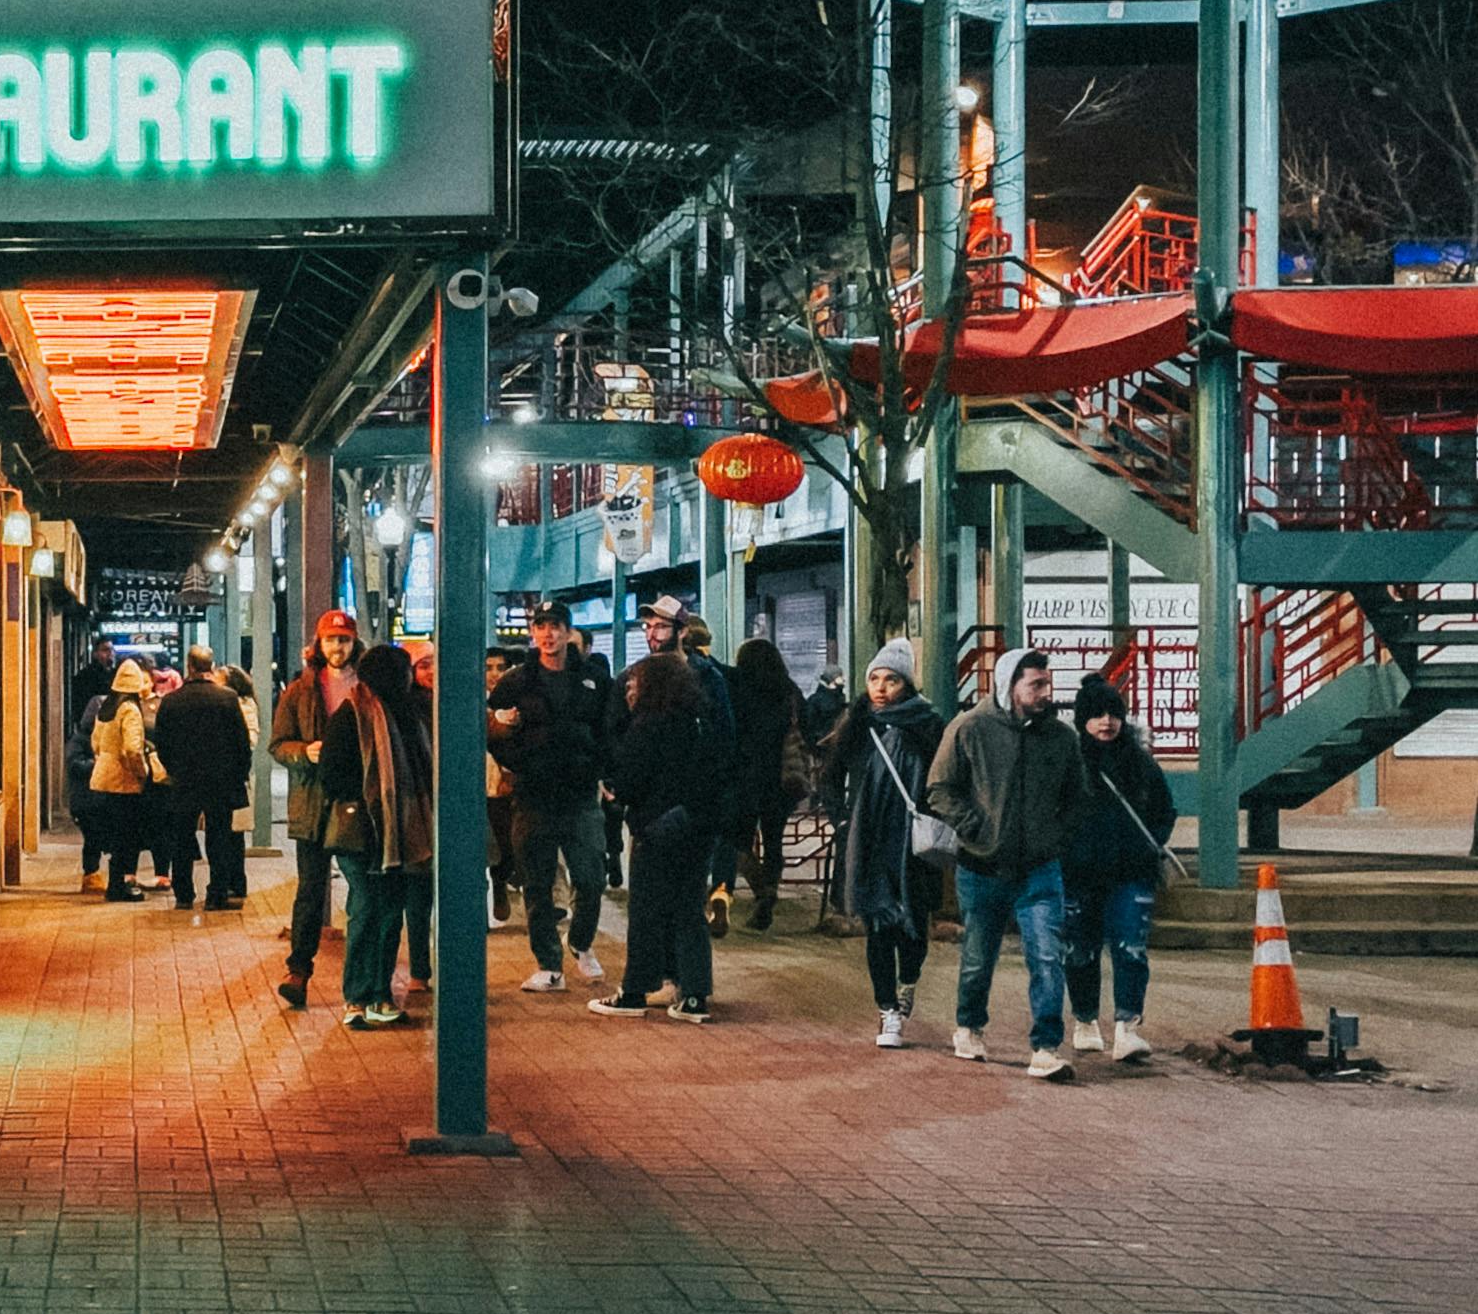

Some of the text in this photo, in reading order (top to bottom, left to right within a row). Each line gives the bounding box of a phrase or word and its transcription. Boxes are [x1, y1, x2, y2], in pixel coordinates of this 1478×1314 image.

[1024, 599, 1075, 619] HARP
[1079, 599, 1143, 619] VISN
[1144, 598, 1179, 619] EYE
[141, 622, 179, 633] HOUSE
